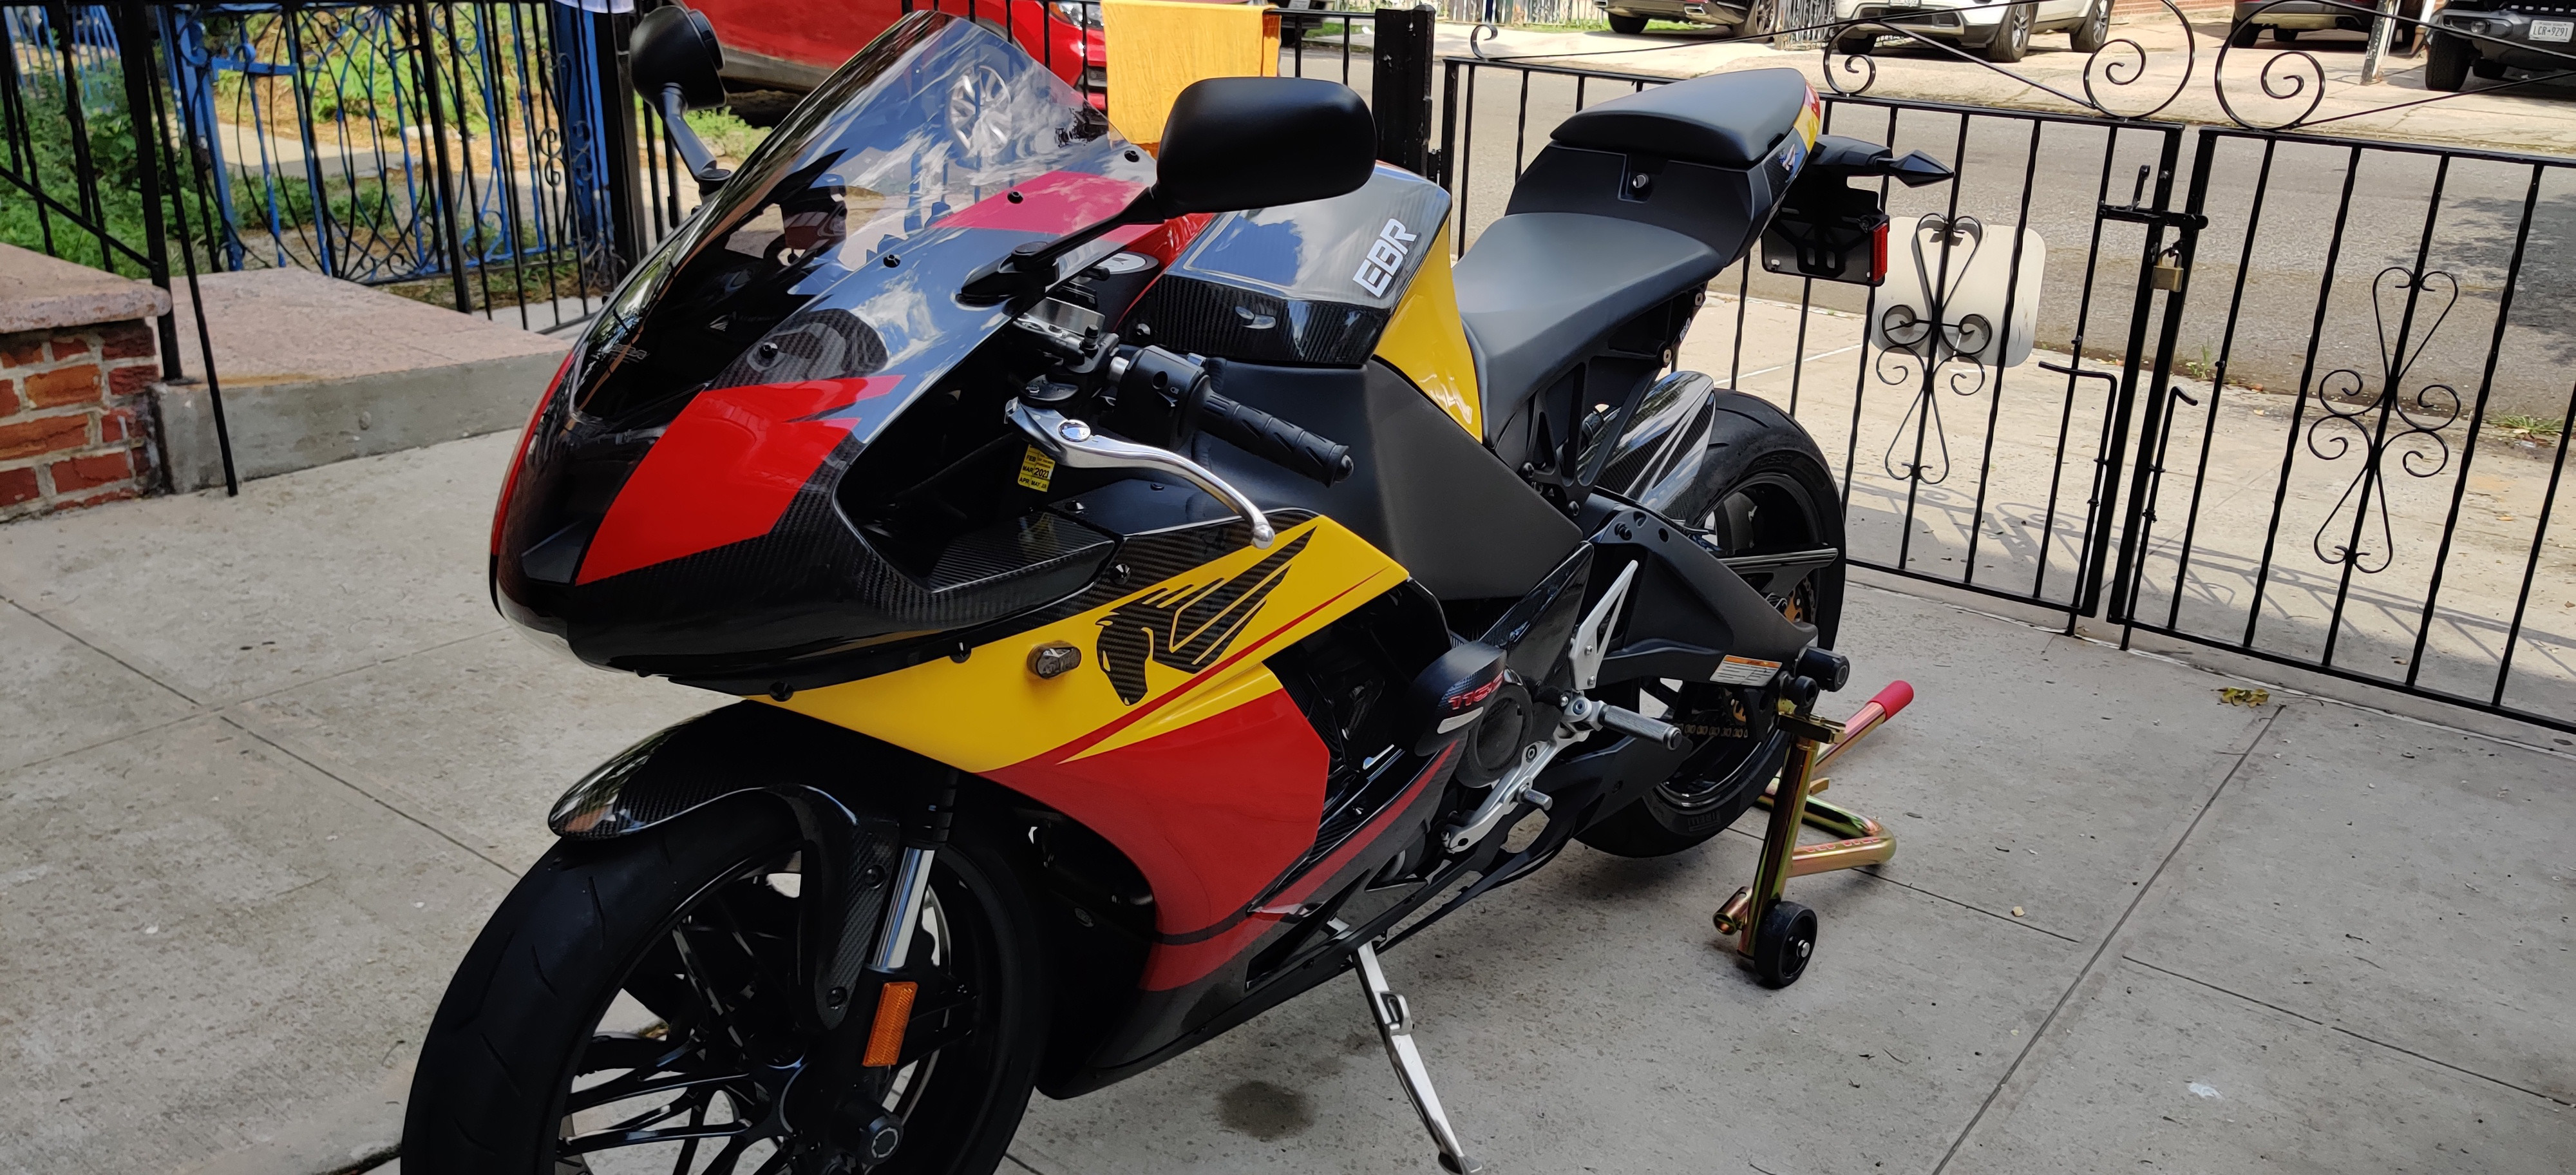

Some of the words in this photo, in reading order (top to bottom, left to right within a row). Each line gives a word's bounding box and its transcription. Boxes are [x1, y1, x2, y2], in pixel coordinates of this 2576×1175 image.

[2533, 26, 2547, 35] LCR
[2551, 27, 2568, 37] 9291
[1352, 218, 1417, 298] EBR
[1034, 468, 1049, 478] 2023
